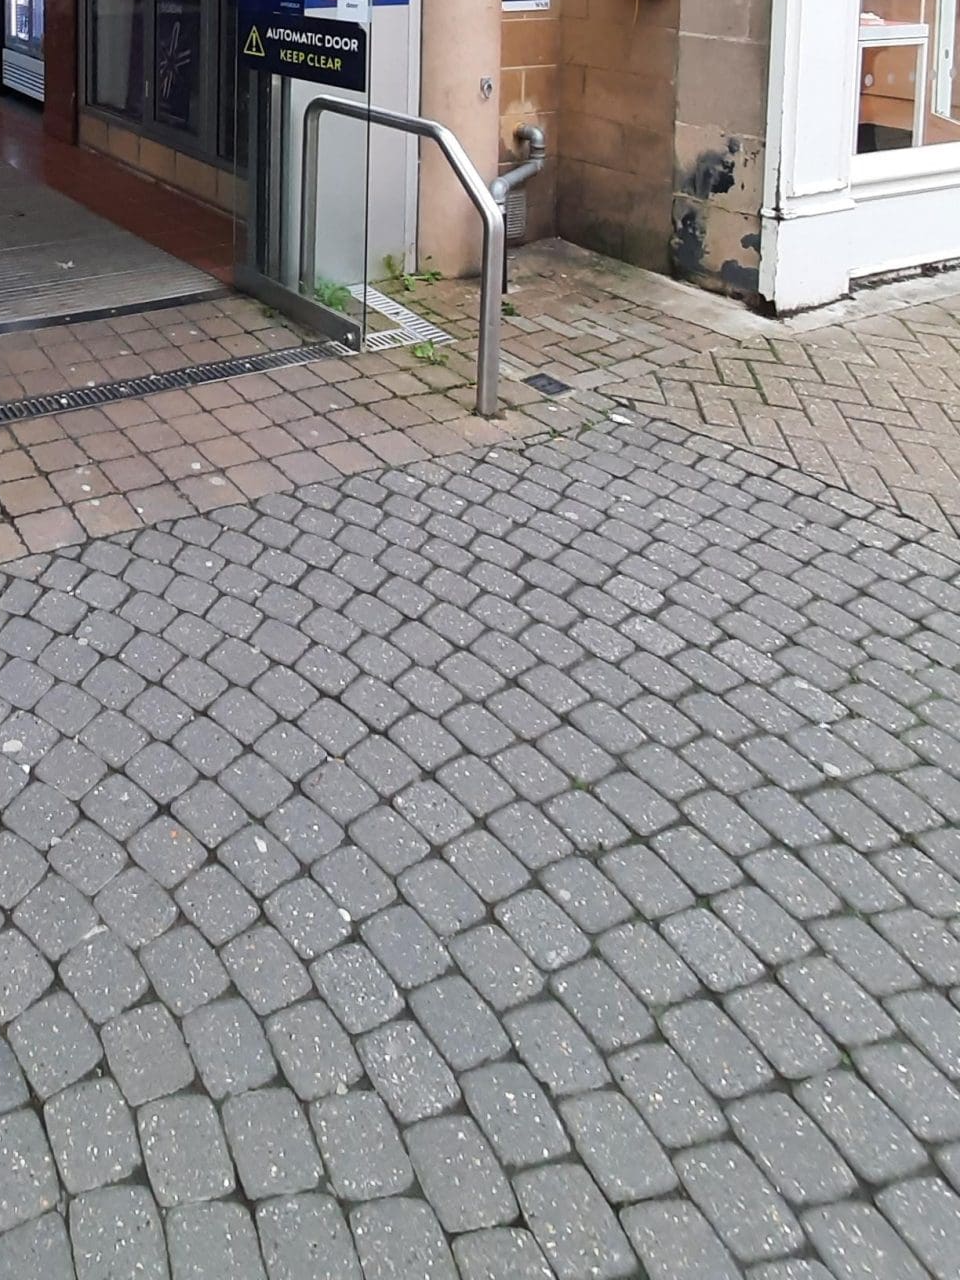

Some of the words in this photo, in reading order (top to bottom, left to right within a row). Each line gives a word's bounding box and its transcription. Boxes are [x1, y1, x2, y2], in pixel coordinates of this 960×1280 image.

[266, 27, 323, 46] AUTOMATIC
[325, 35, 359, 52] DOOR
[280, 49, 305, 64] KEEP
[307, 54, 342, 71] CLEAR
